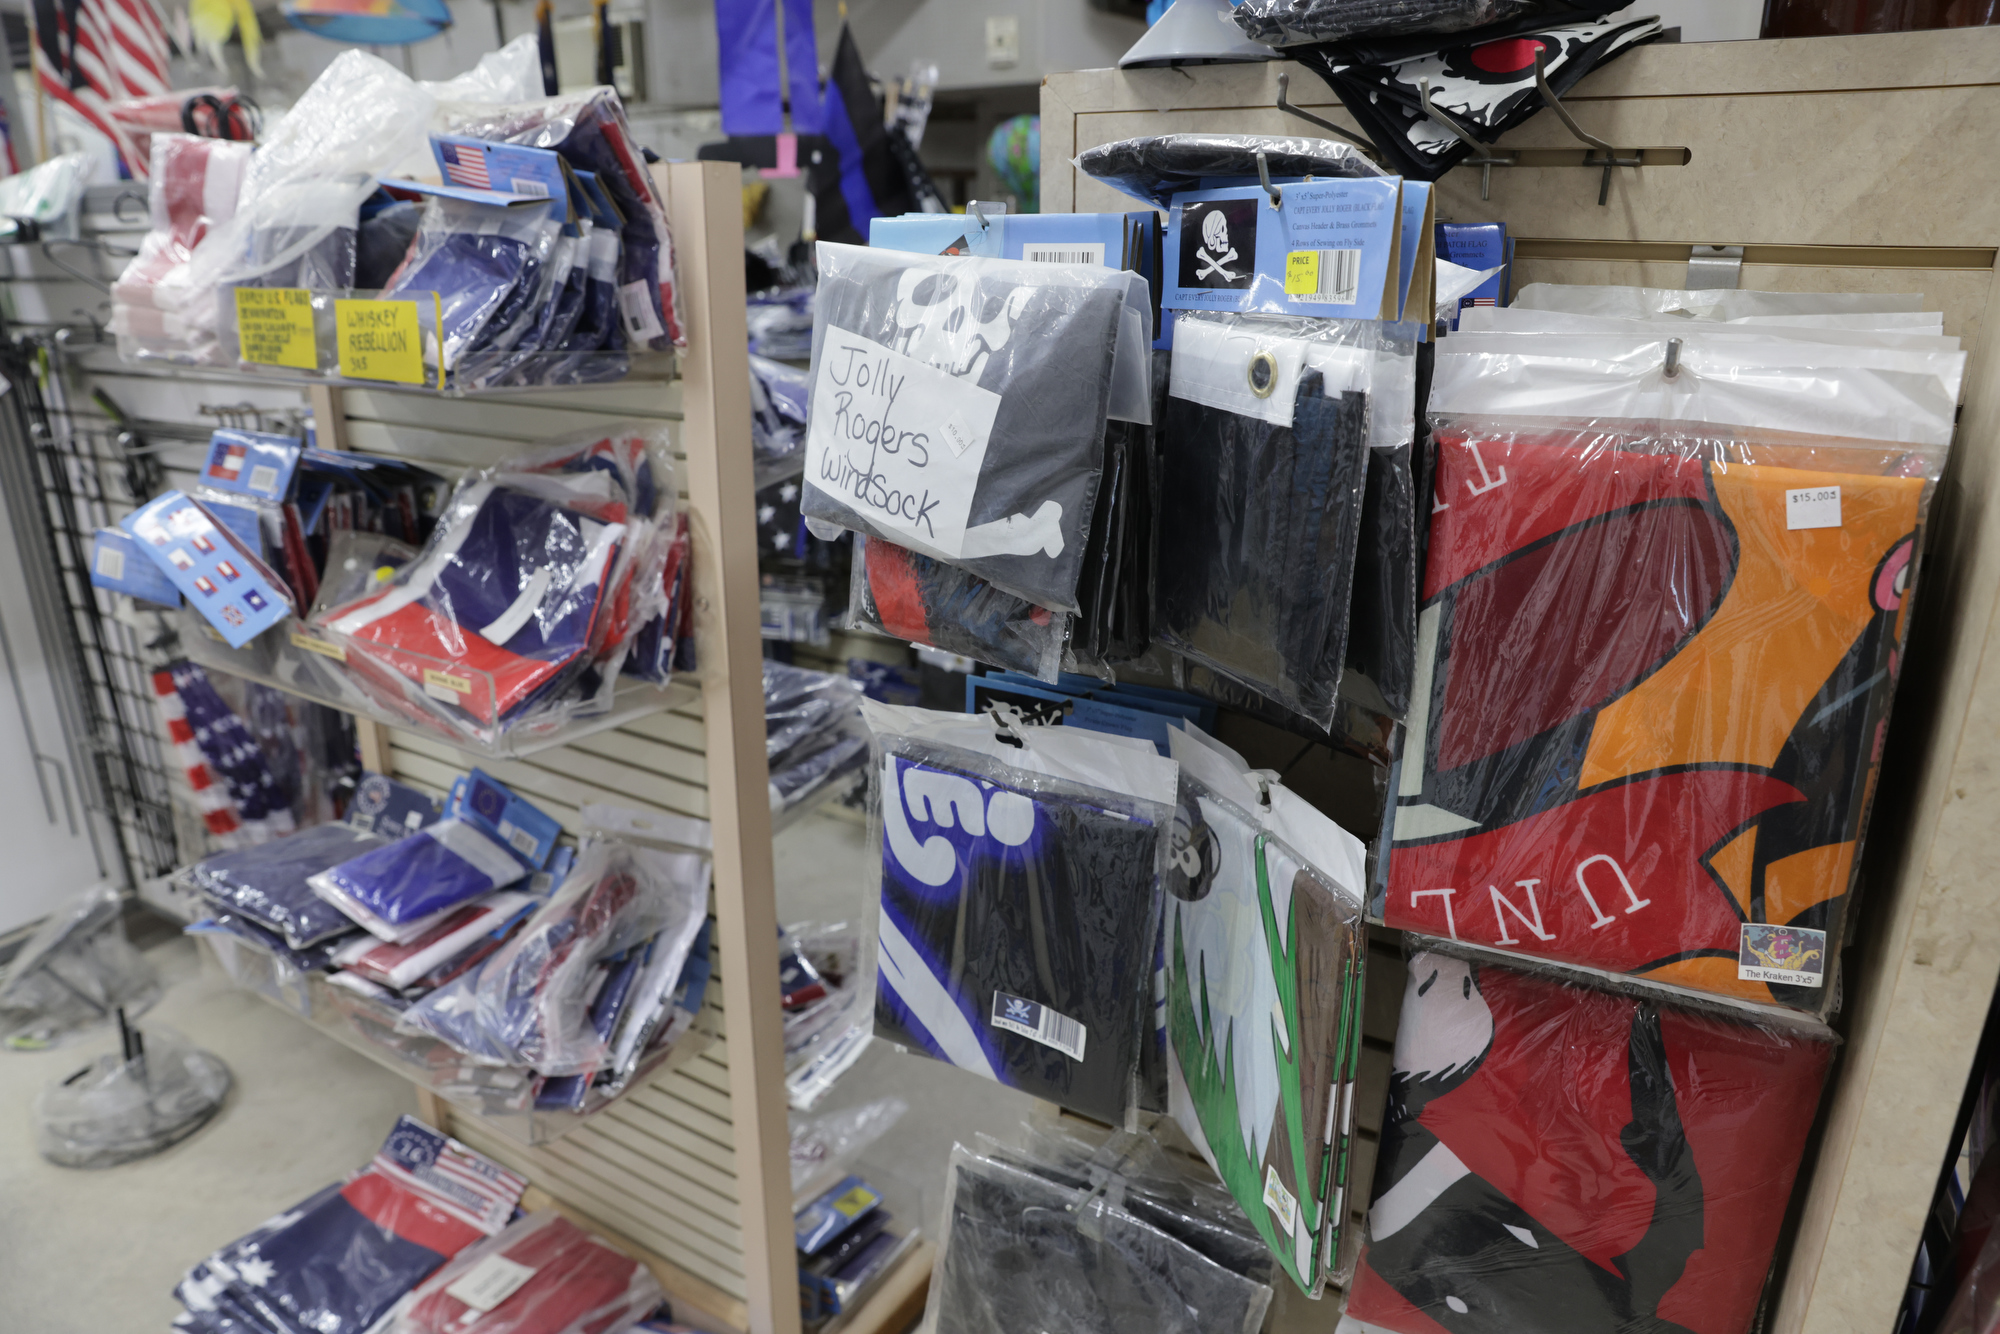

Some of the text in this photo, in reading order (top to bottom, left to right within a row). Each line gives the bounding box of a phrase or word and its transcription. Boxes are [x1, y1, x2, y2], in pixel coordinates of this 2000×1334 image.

[1310, 191, 1348, 201] Super-Polyester
[1294, 206, 1306, 214] CAPT
[1306, 206, 1320, 214] EVERY
[1321, 205, 1335, 214] JOLLY
[1336, 204, 1352, 213] ROGER
[1292, 222, 1310, 230] Canvas
[1311, 222, 1328, 230] Header
[1336, 221, 1350, 229] Brass
[1351, 220, 1377, 229] Grommets
[1310, 239, 1316, 247] of
[1316, 239, 1335, 248] Sewing
[1344, 239, 1352, 248] Fly
[1468, 240, 1488, 248] FLAG
[1450, 251, 1485, 259] Grommets
[1292, 256, 1310, 265] PRICE
[346, 306, 398, 329] WHISKEY
[349, 329, 407, 352] REBELLION
[830, 345, 905, 405] Jolly
[834, 391, 930, 477] Rogers
[1745, 969, 1814, 984] The Kraken 3'x5'
